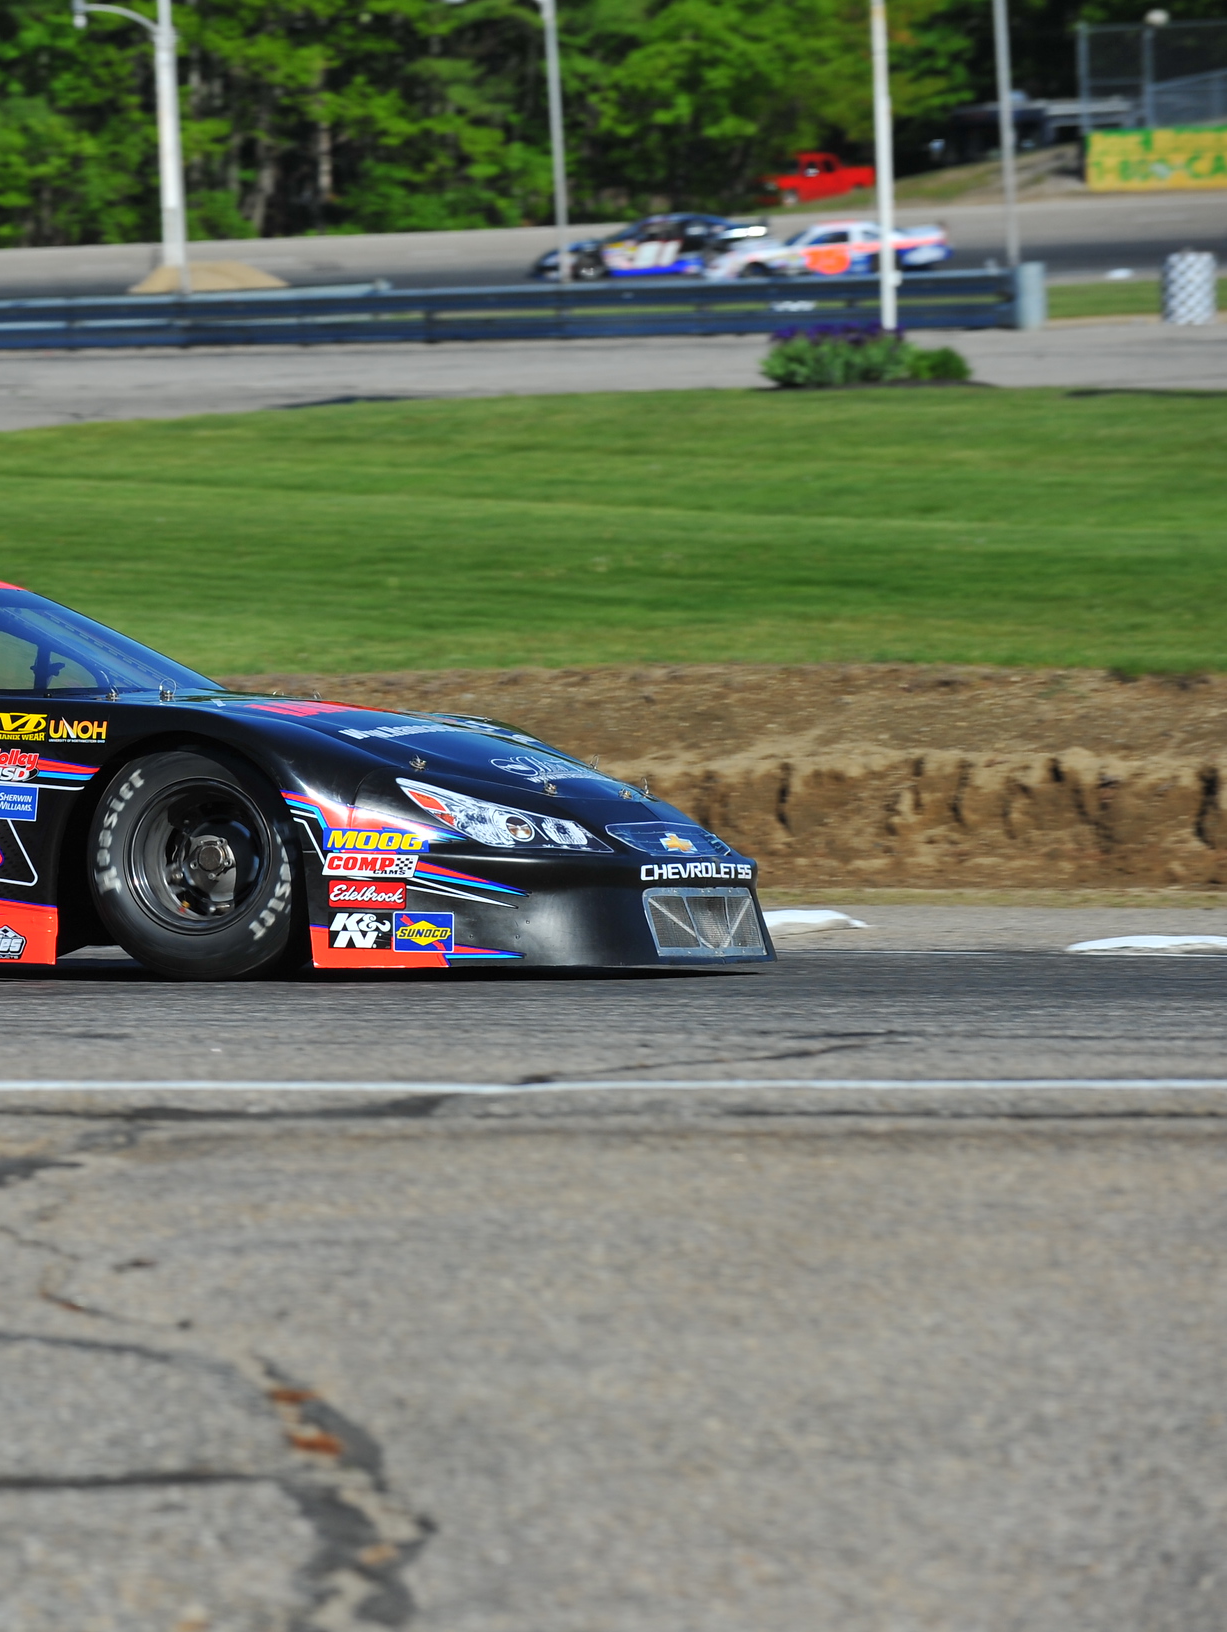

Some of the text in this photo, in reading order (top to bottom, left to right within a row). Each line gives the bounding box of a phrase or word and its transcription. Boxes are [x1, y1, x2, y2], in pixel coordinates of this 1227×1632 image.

[21, 731, 45, 741] WEAR
[48, 716, 108, 739] UNOH
[327, 830, 423, 850] MOOG
[327, 856, 395, 872] COMP
[640, 862, 736, 881] CHEVROLET
[329, 884, 404, 904] Edelbrock
[398, 928, 450, 939] SUNOCO
